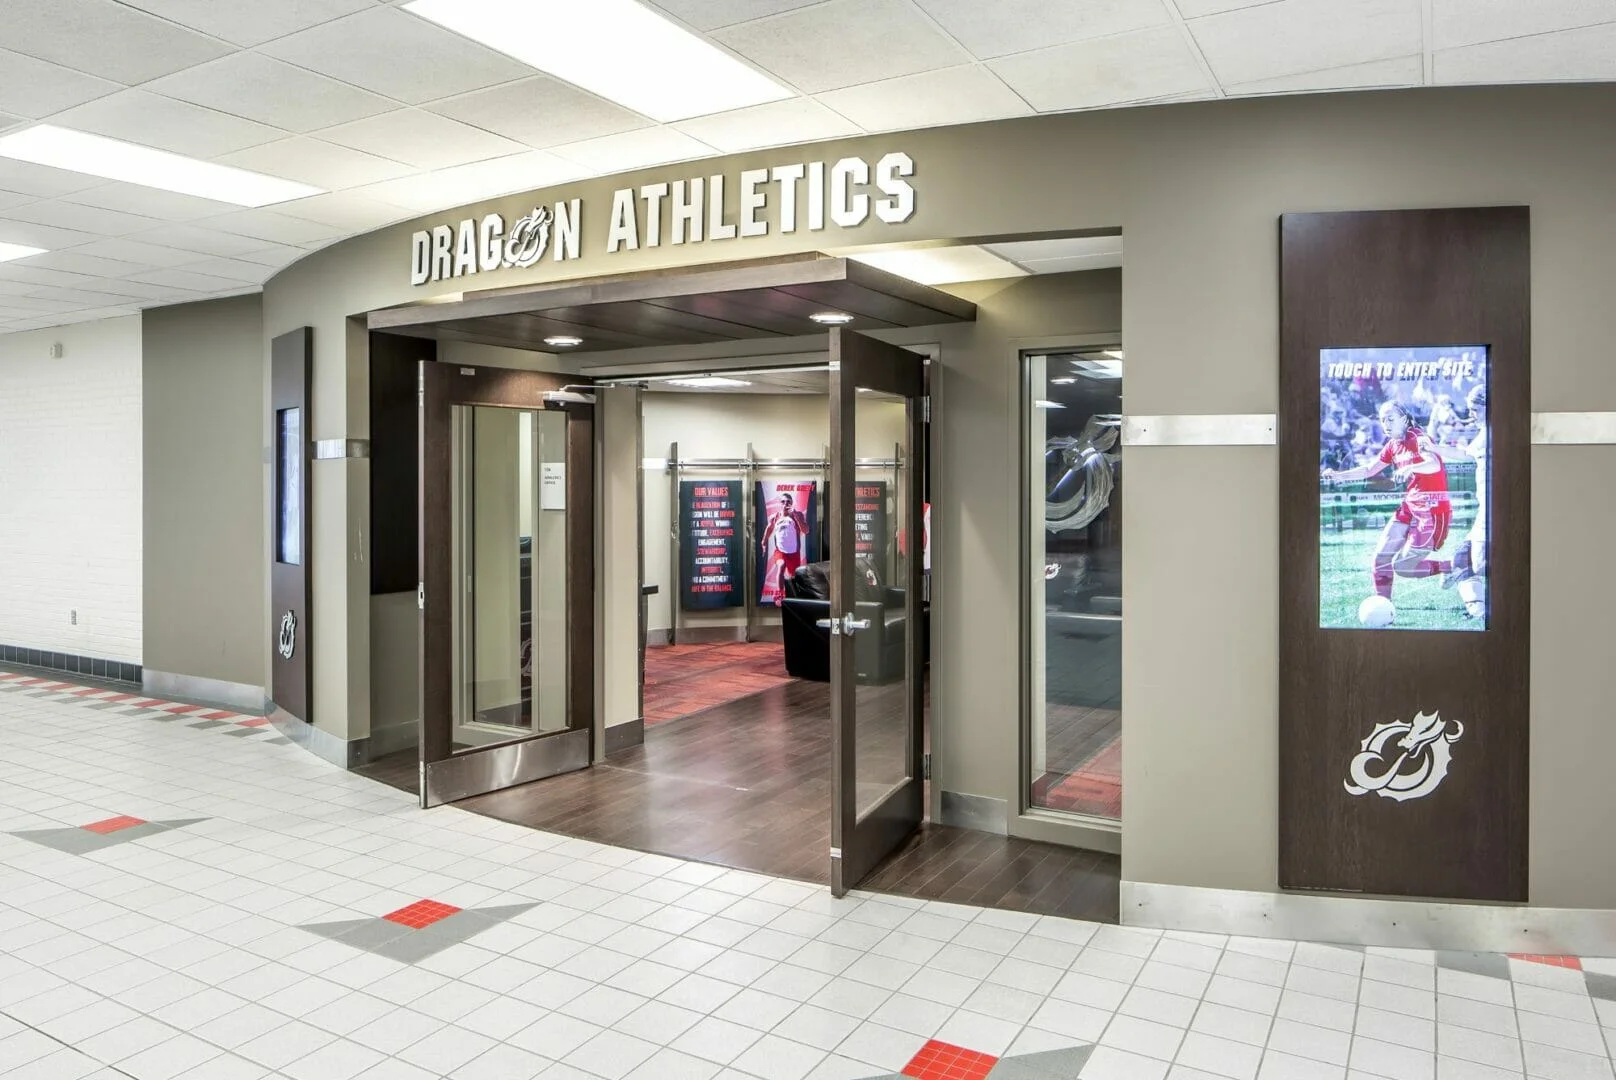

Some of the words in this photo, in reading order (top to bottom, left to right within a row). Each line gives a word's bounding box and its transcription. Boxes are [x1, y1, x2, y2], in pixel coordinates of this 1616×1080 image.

[411, 199, 582, 286] DRAGON
[607, 152, 916, 253] ATHLETICS
[1328, 363, 1372, 379] TOUCH
[1376, 363, 1394, 379] TO
[1397, 361, 1438, 378] ENTER
[1442, 361, 1473, 377] SITE
[694, 487, 706, 497] OUR
[707, 487, 728, 497] VALUES
